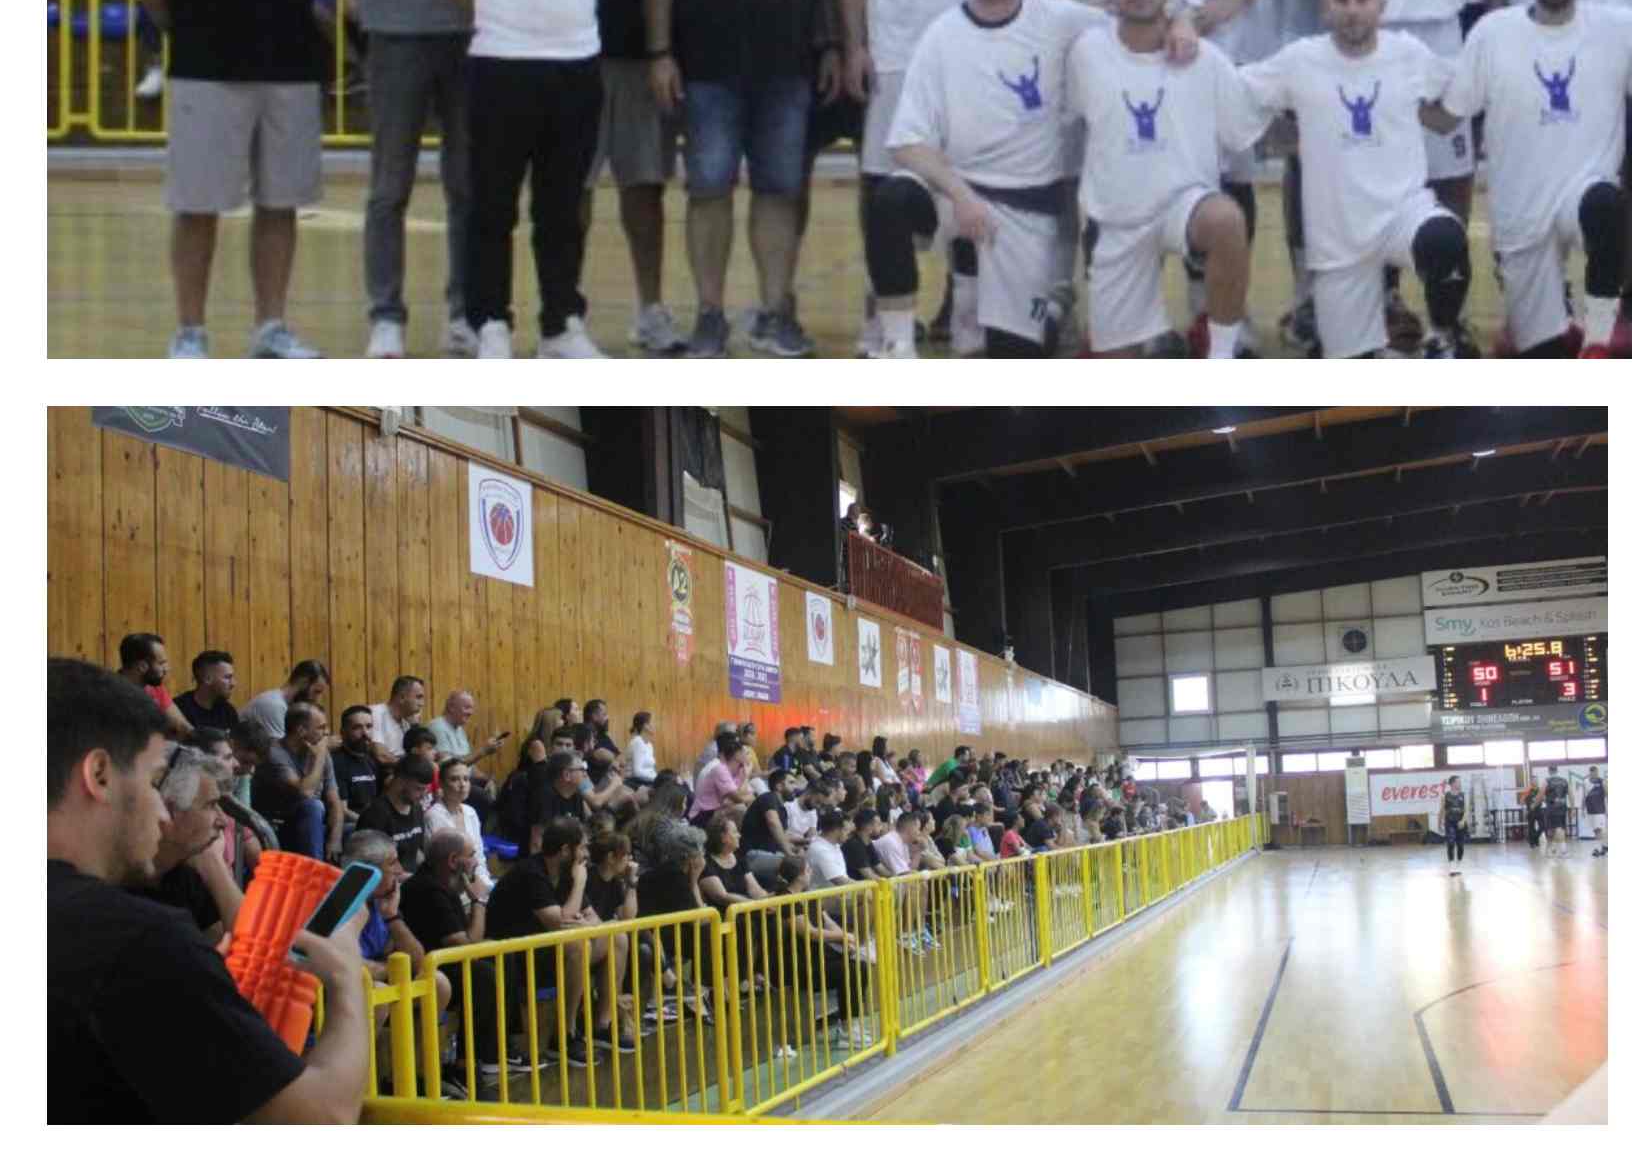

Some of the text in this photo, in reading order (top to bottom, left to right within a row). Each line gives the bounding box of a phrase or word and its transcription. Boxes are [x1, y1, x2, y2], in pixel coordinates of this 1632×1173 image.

[1473, 666, 1498, 681] 50
[1549, 661, 1575, 676] 51
[1563, 682, 1576, 697] 3
